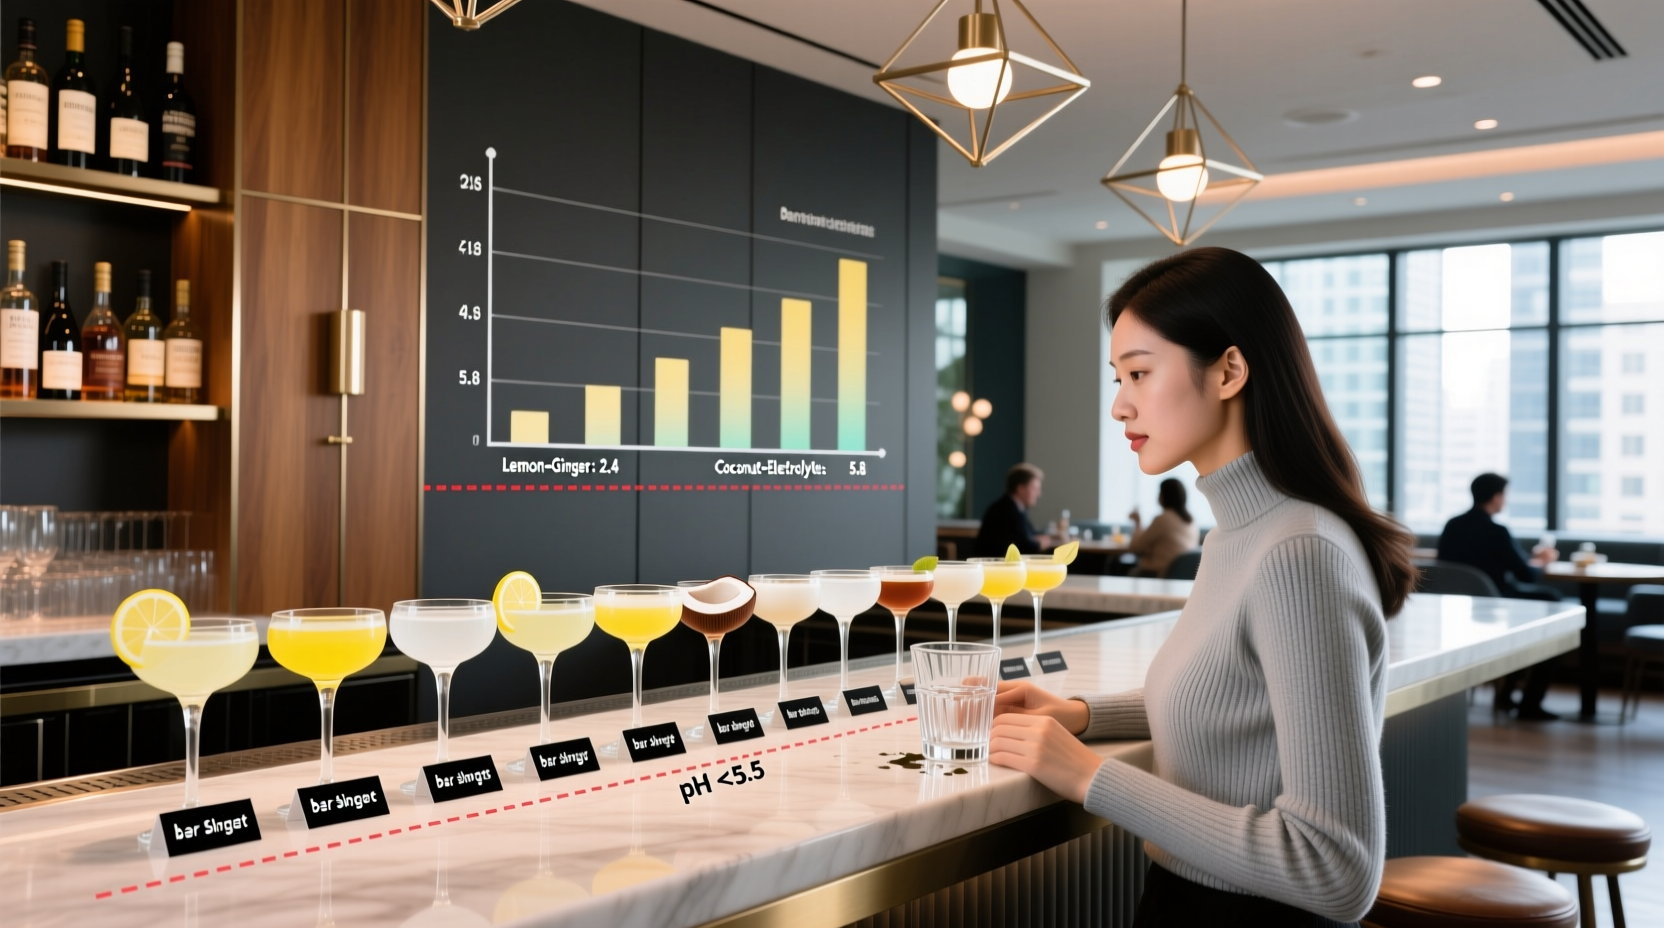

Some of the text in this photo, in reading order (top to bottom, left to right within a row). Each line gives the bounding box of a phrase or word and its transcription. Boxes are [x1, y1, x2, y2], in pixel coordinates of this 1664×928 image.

[458, 369, 480, 386] 5.8
[502, 456, 620, 478] Lemon-Ginger: 2.4
[849, 460, 867, 476] 5.8
[679, 759, 765, 805] pH <5.5
[173, 823, 201, 841] bar
